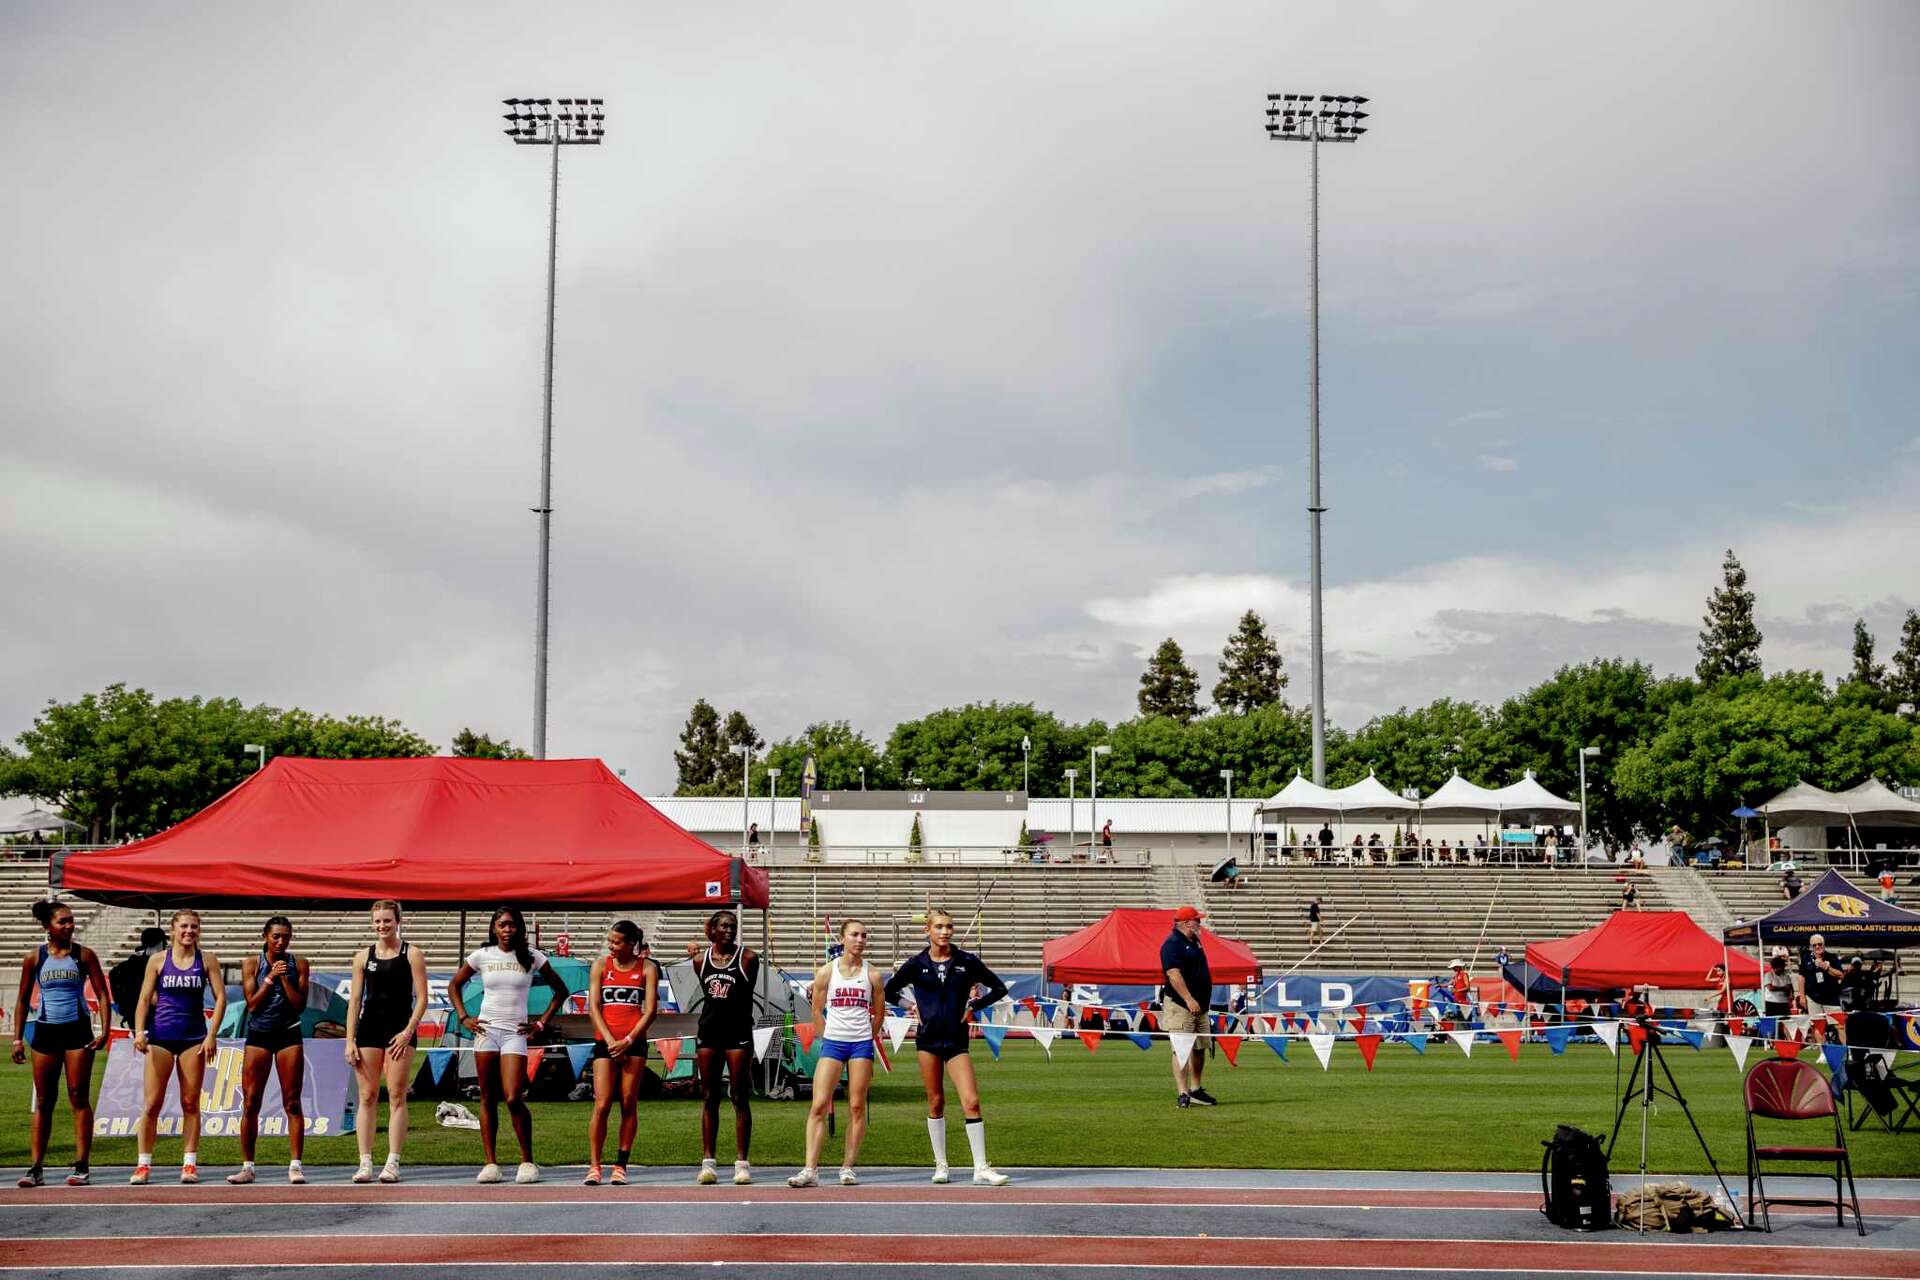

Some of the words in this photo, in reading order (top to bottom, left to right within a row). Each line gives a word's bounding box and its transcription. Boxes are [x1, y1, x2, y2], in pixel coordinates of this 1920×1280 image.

[1772, 925, 1818, 933] CALIFORNIA
[1818, 924, 1887, 932] INTERSCHOLASTIC
[162, 975, 202, 988] SHASTA
[708, 979, 731, 998] SM
[602, 988, 640, 1004] CCA
[835, 987, 866, 998] SAINT
[94, 1117, 330, 1135] CHMONHPS
